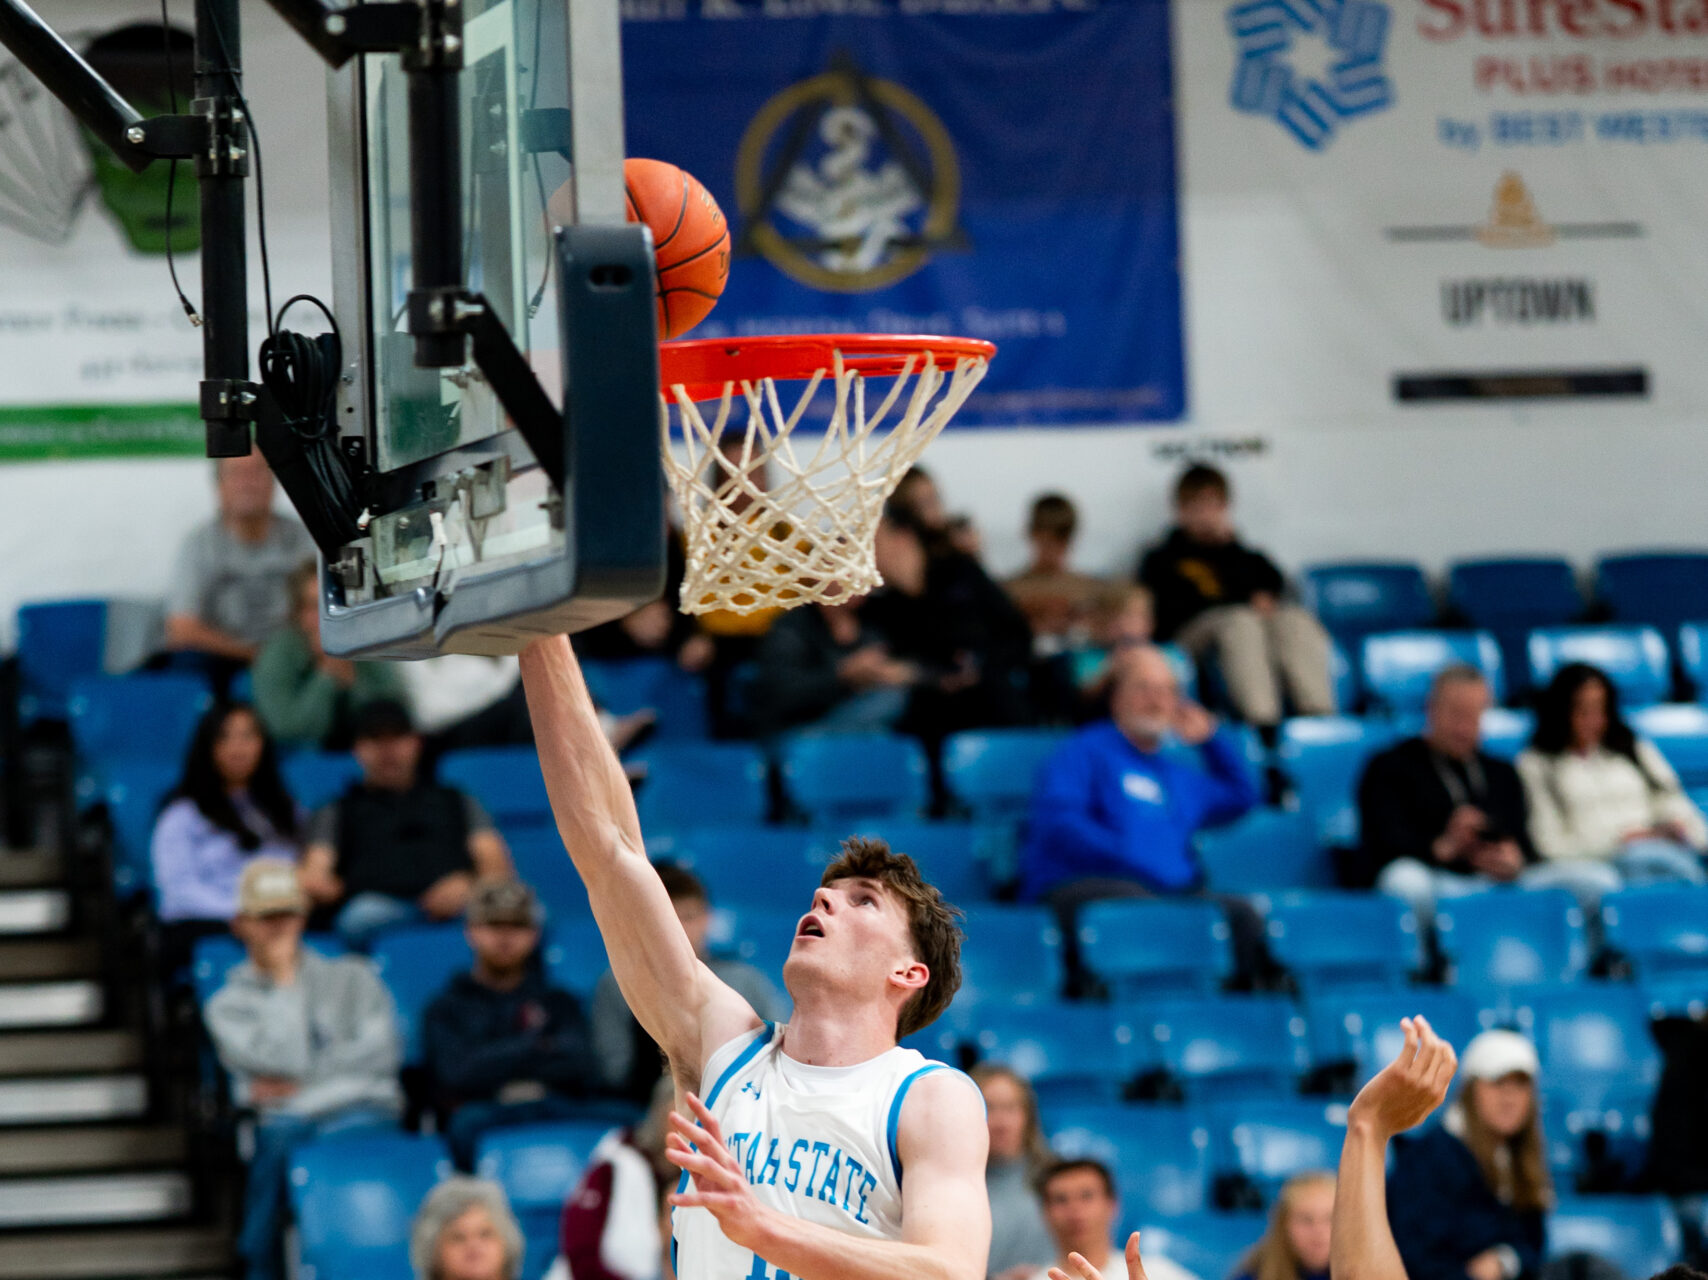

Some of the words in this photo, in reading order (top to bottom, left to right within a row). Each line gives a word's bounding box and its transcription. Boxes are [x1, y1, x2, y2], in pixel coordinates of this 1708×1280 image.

[1475, 55, 1596, 96] PLUS
[1437, 115, 1478, 155] by
[1490, 110, 1583, 146] BEST
[1441, 277, 1594, 326] UPTOWN
[728, 1131, 780, 1185] TAH
[784, 1138, 877, 1224] STATE
